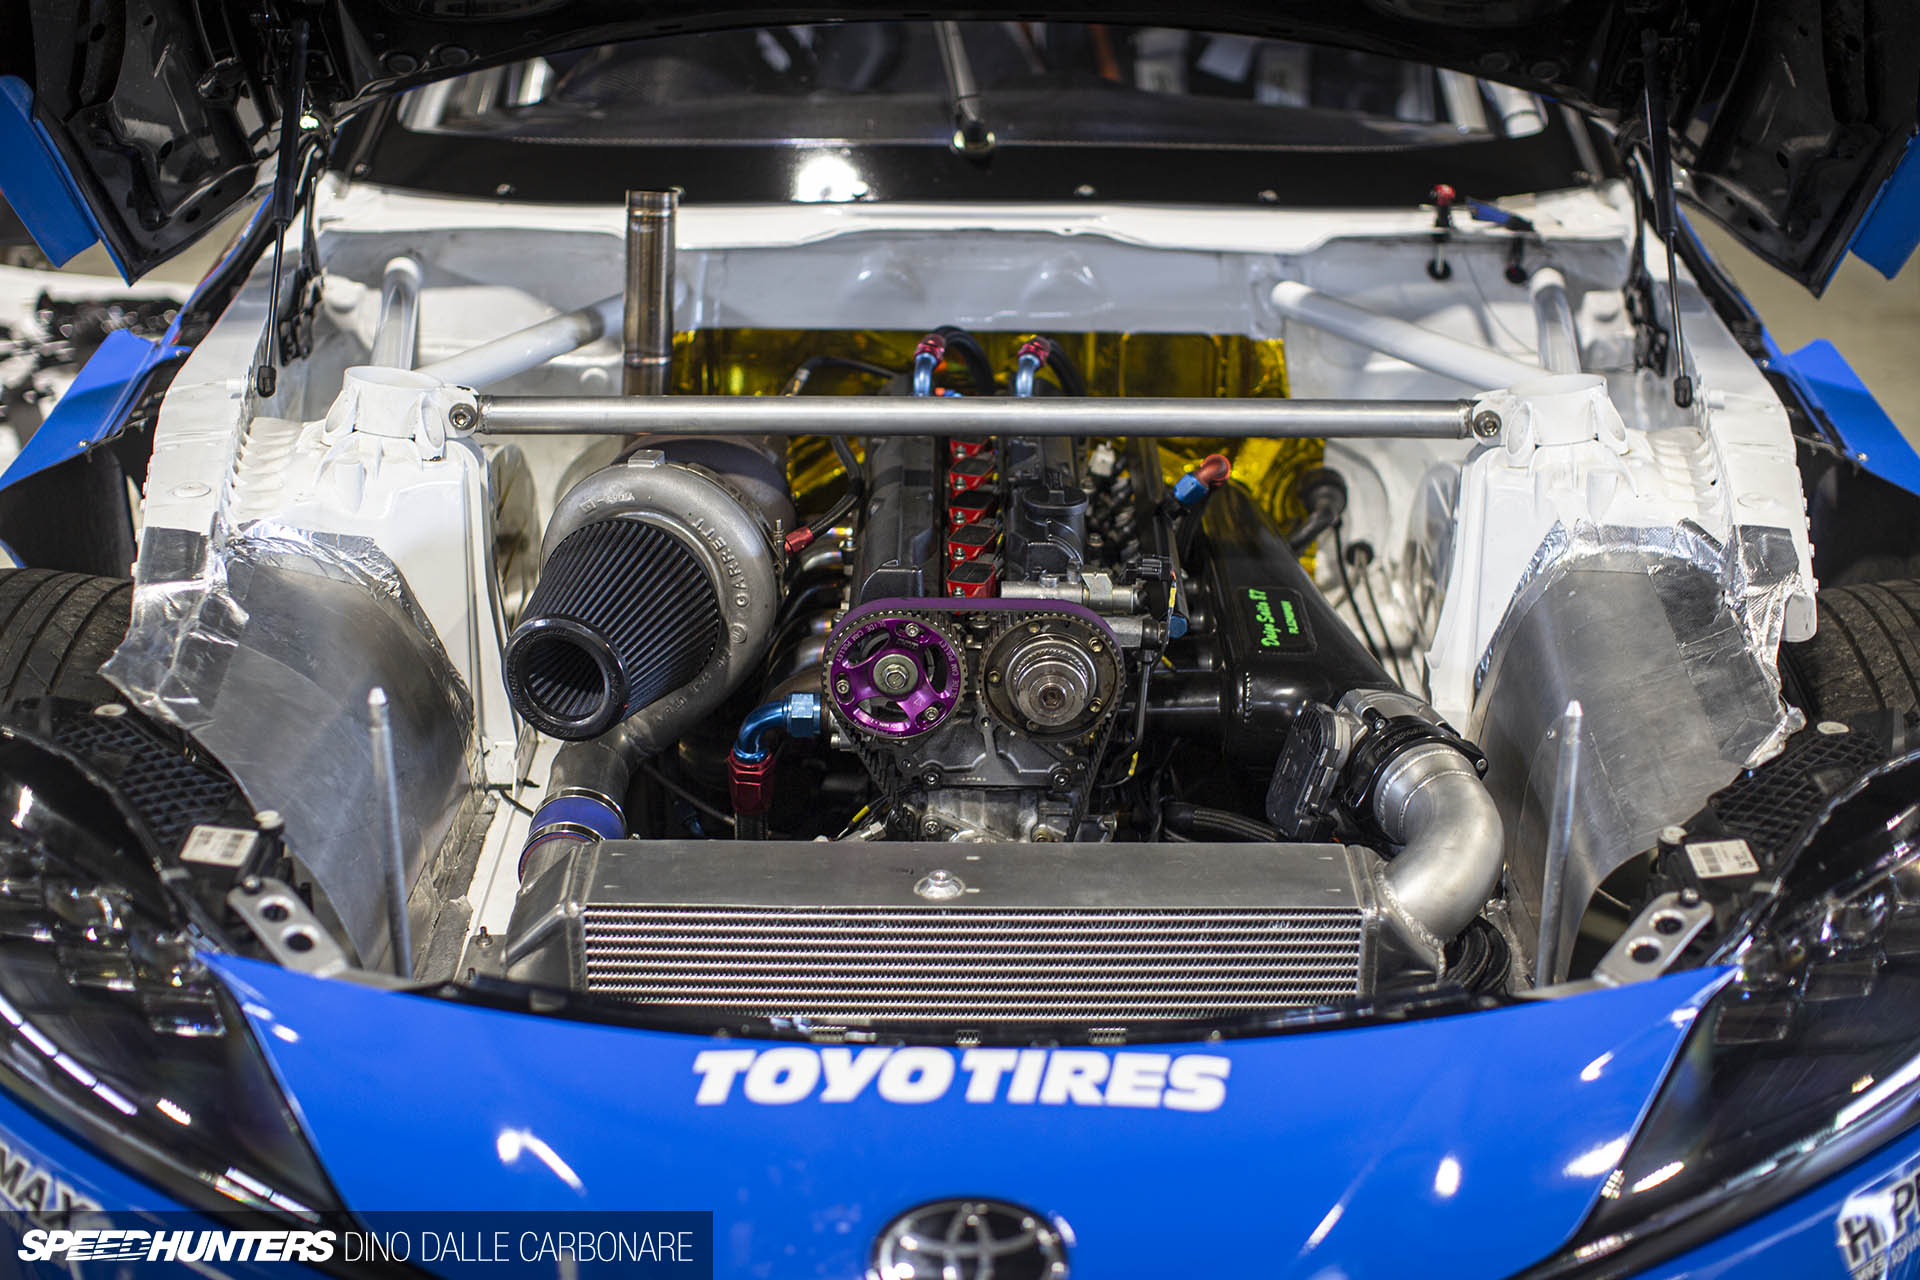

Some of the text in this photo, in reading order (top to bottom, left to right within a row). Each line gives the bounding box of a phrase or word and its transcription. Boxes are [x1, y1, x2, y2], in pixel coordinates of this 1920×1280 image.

[691, 518, 750, 609] GARRETT
[693, 1047, 1231, 1112] TOYO TIRES
